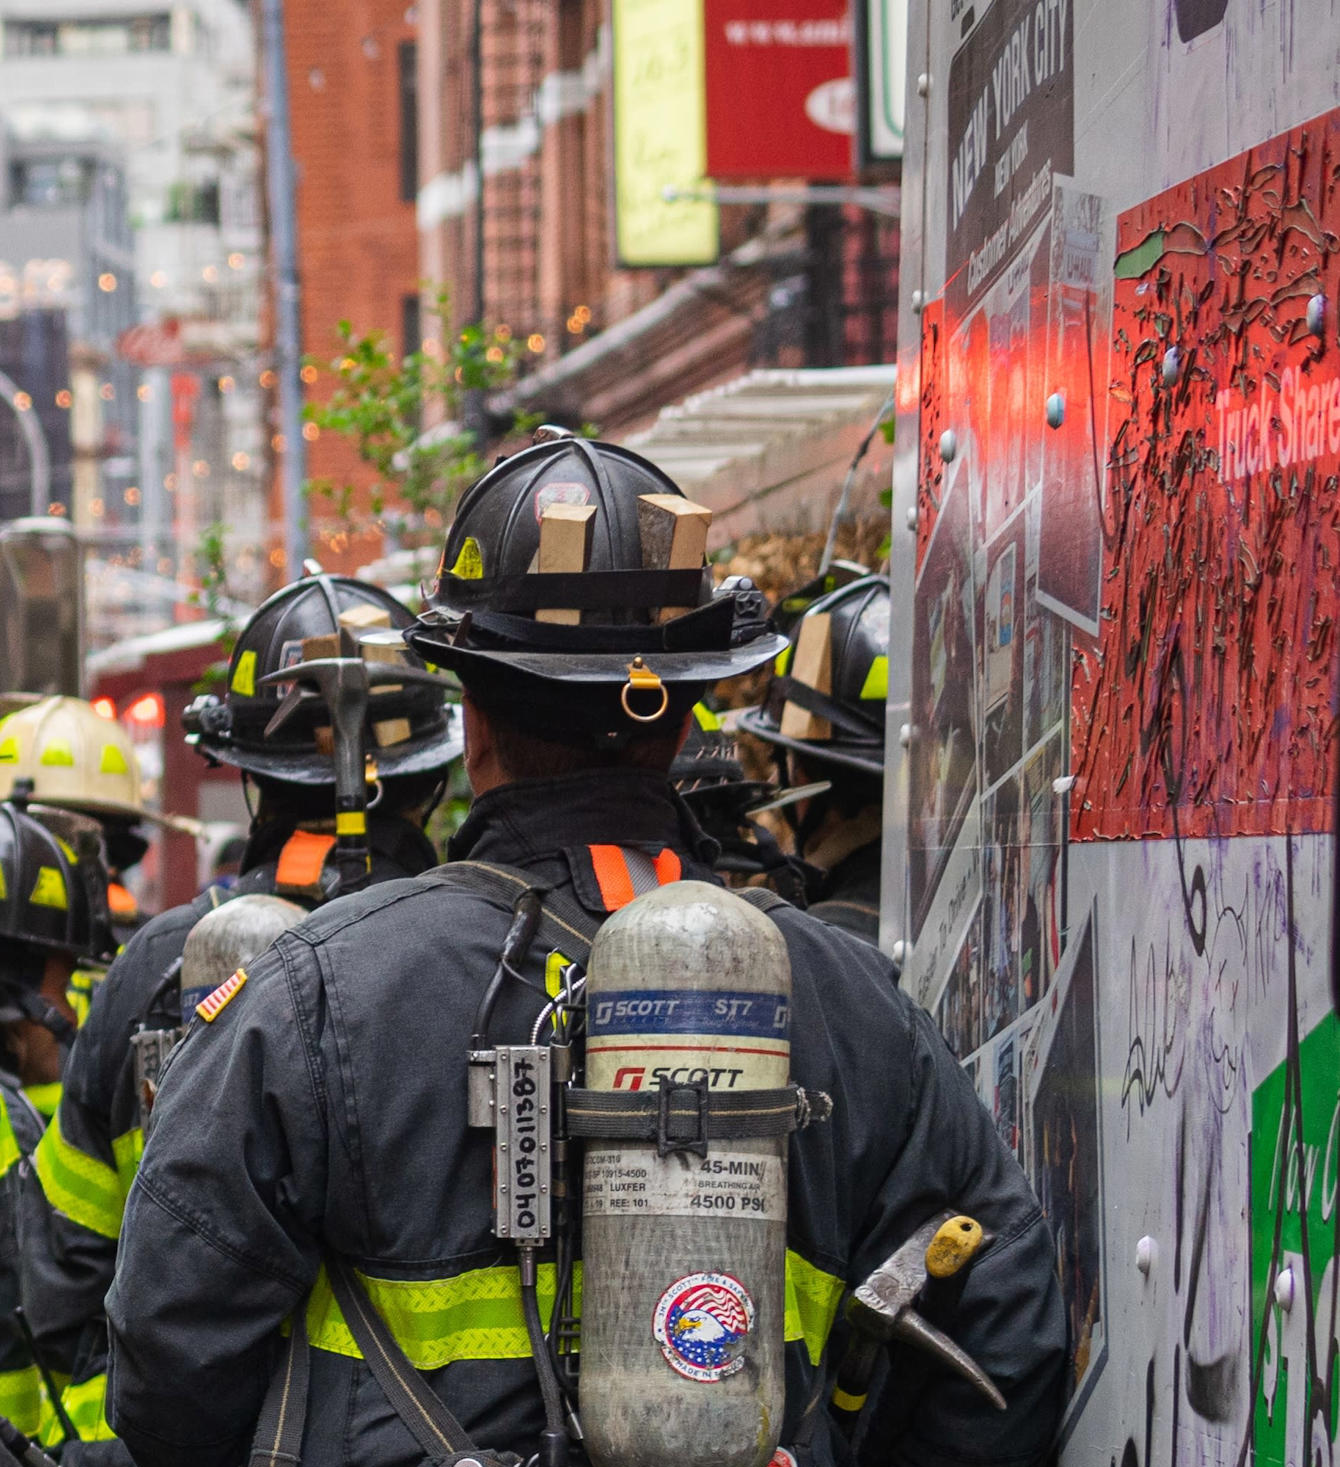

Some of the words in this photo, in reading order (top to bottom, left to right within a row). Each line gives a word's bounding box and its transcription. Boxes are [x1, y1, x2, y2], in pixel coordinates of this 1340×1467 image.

[952, 85, 989, 231] NEW
[993, 14, 1031, 141] YORK
[1034, 0, 1067, 87] CITY
[1215, 376, 1272, 483] Truck
[615, 1000, 681, 1017] SCOTT
[715, 999, 752, 1015] ST7
[648, 1067, 744, 1088] SCOTT
[700, 1160, 760, 1177] 45-MIN
[610, 1182, 646, 1192] LUXFER
[697, 1180, 748, 1190] BREATHING
[633, 1197, 649, 1208] 101
[691, 1194, 736, 1210] 4500
